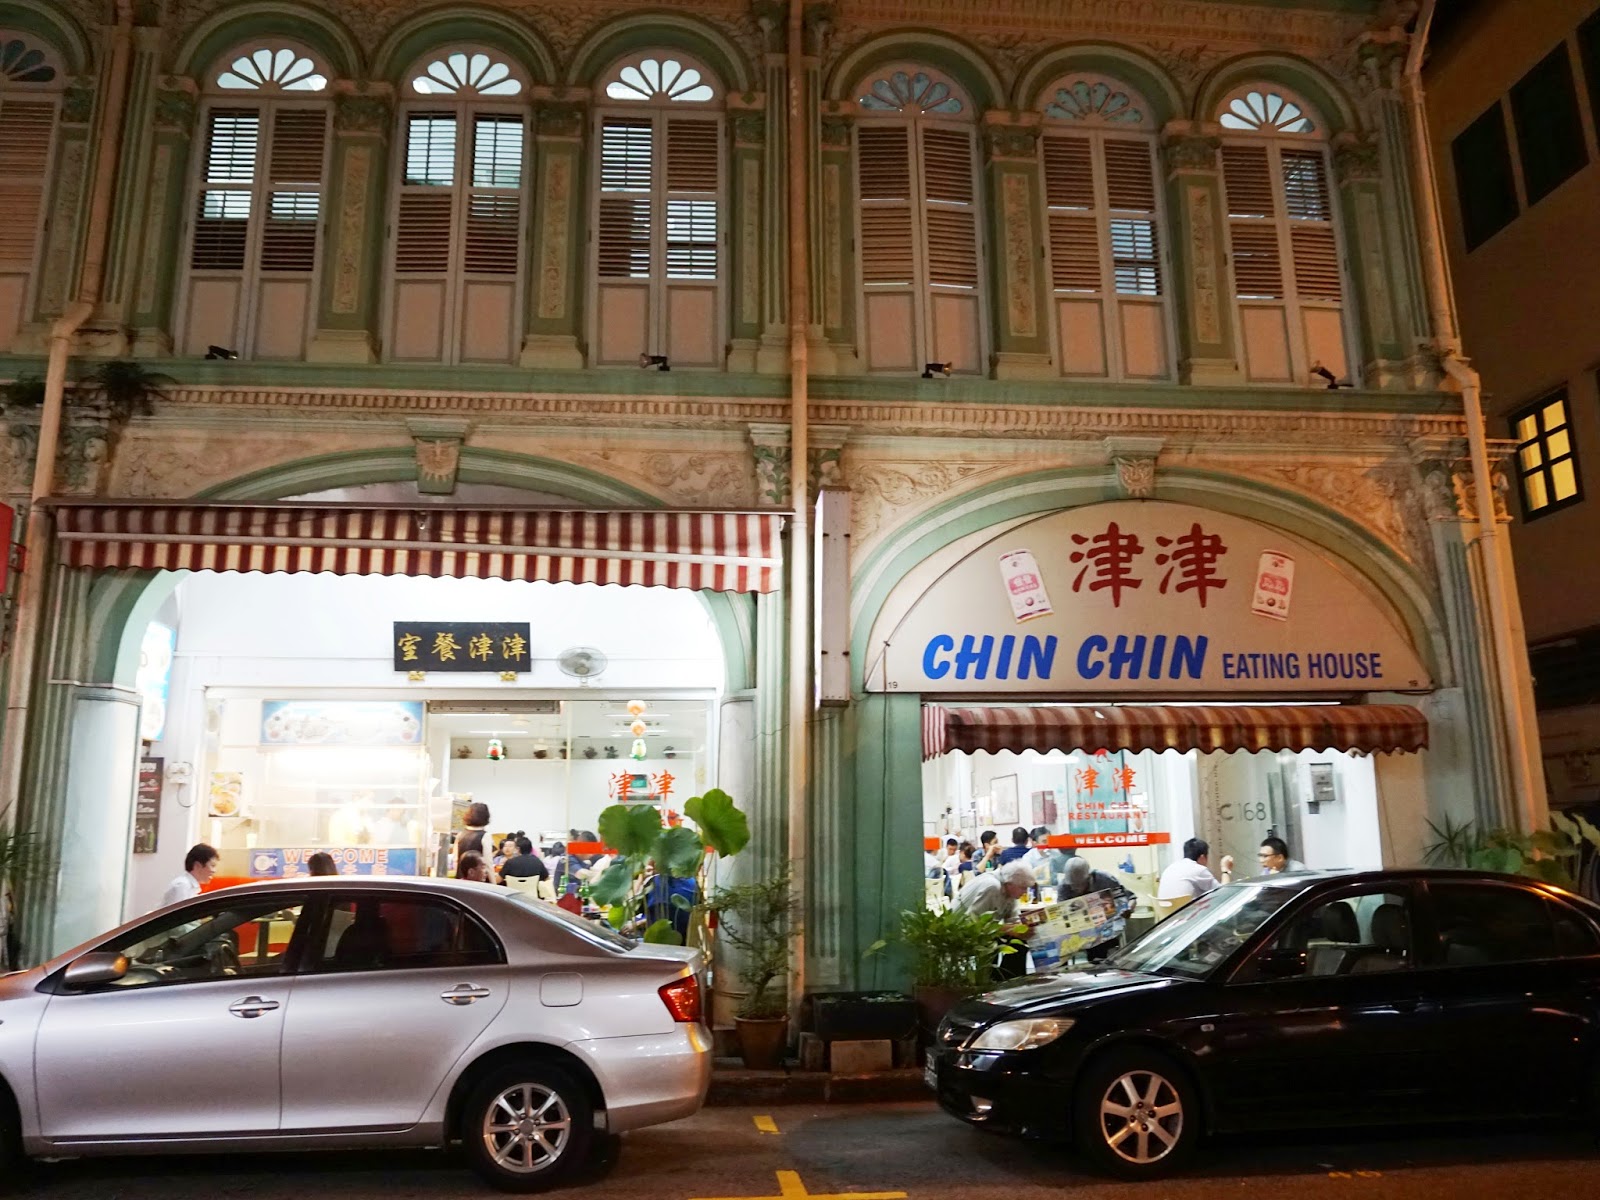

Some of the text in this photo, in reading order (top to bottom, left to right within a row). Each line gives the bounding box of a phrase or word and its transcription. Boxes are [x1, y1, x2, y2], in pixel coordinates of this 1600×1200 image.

[1070, 521, 1228, 609] 津津
[922, 634, 1383, 680] CHIN CHIN EATING HOUSE
[888, 681, 898, 689] 19
[608, 769, 675, 803] 津津
[1074, 764, 1136, 797] 津津
[1076, 802, 1105, 811] CHIN
[1068, 811, 1148, 821] RESTAURANT
[1075, 834, 1148, 845] WELCOME
[282, 849, 389, 864] WECOME
